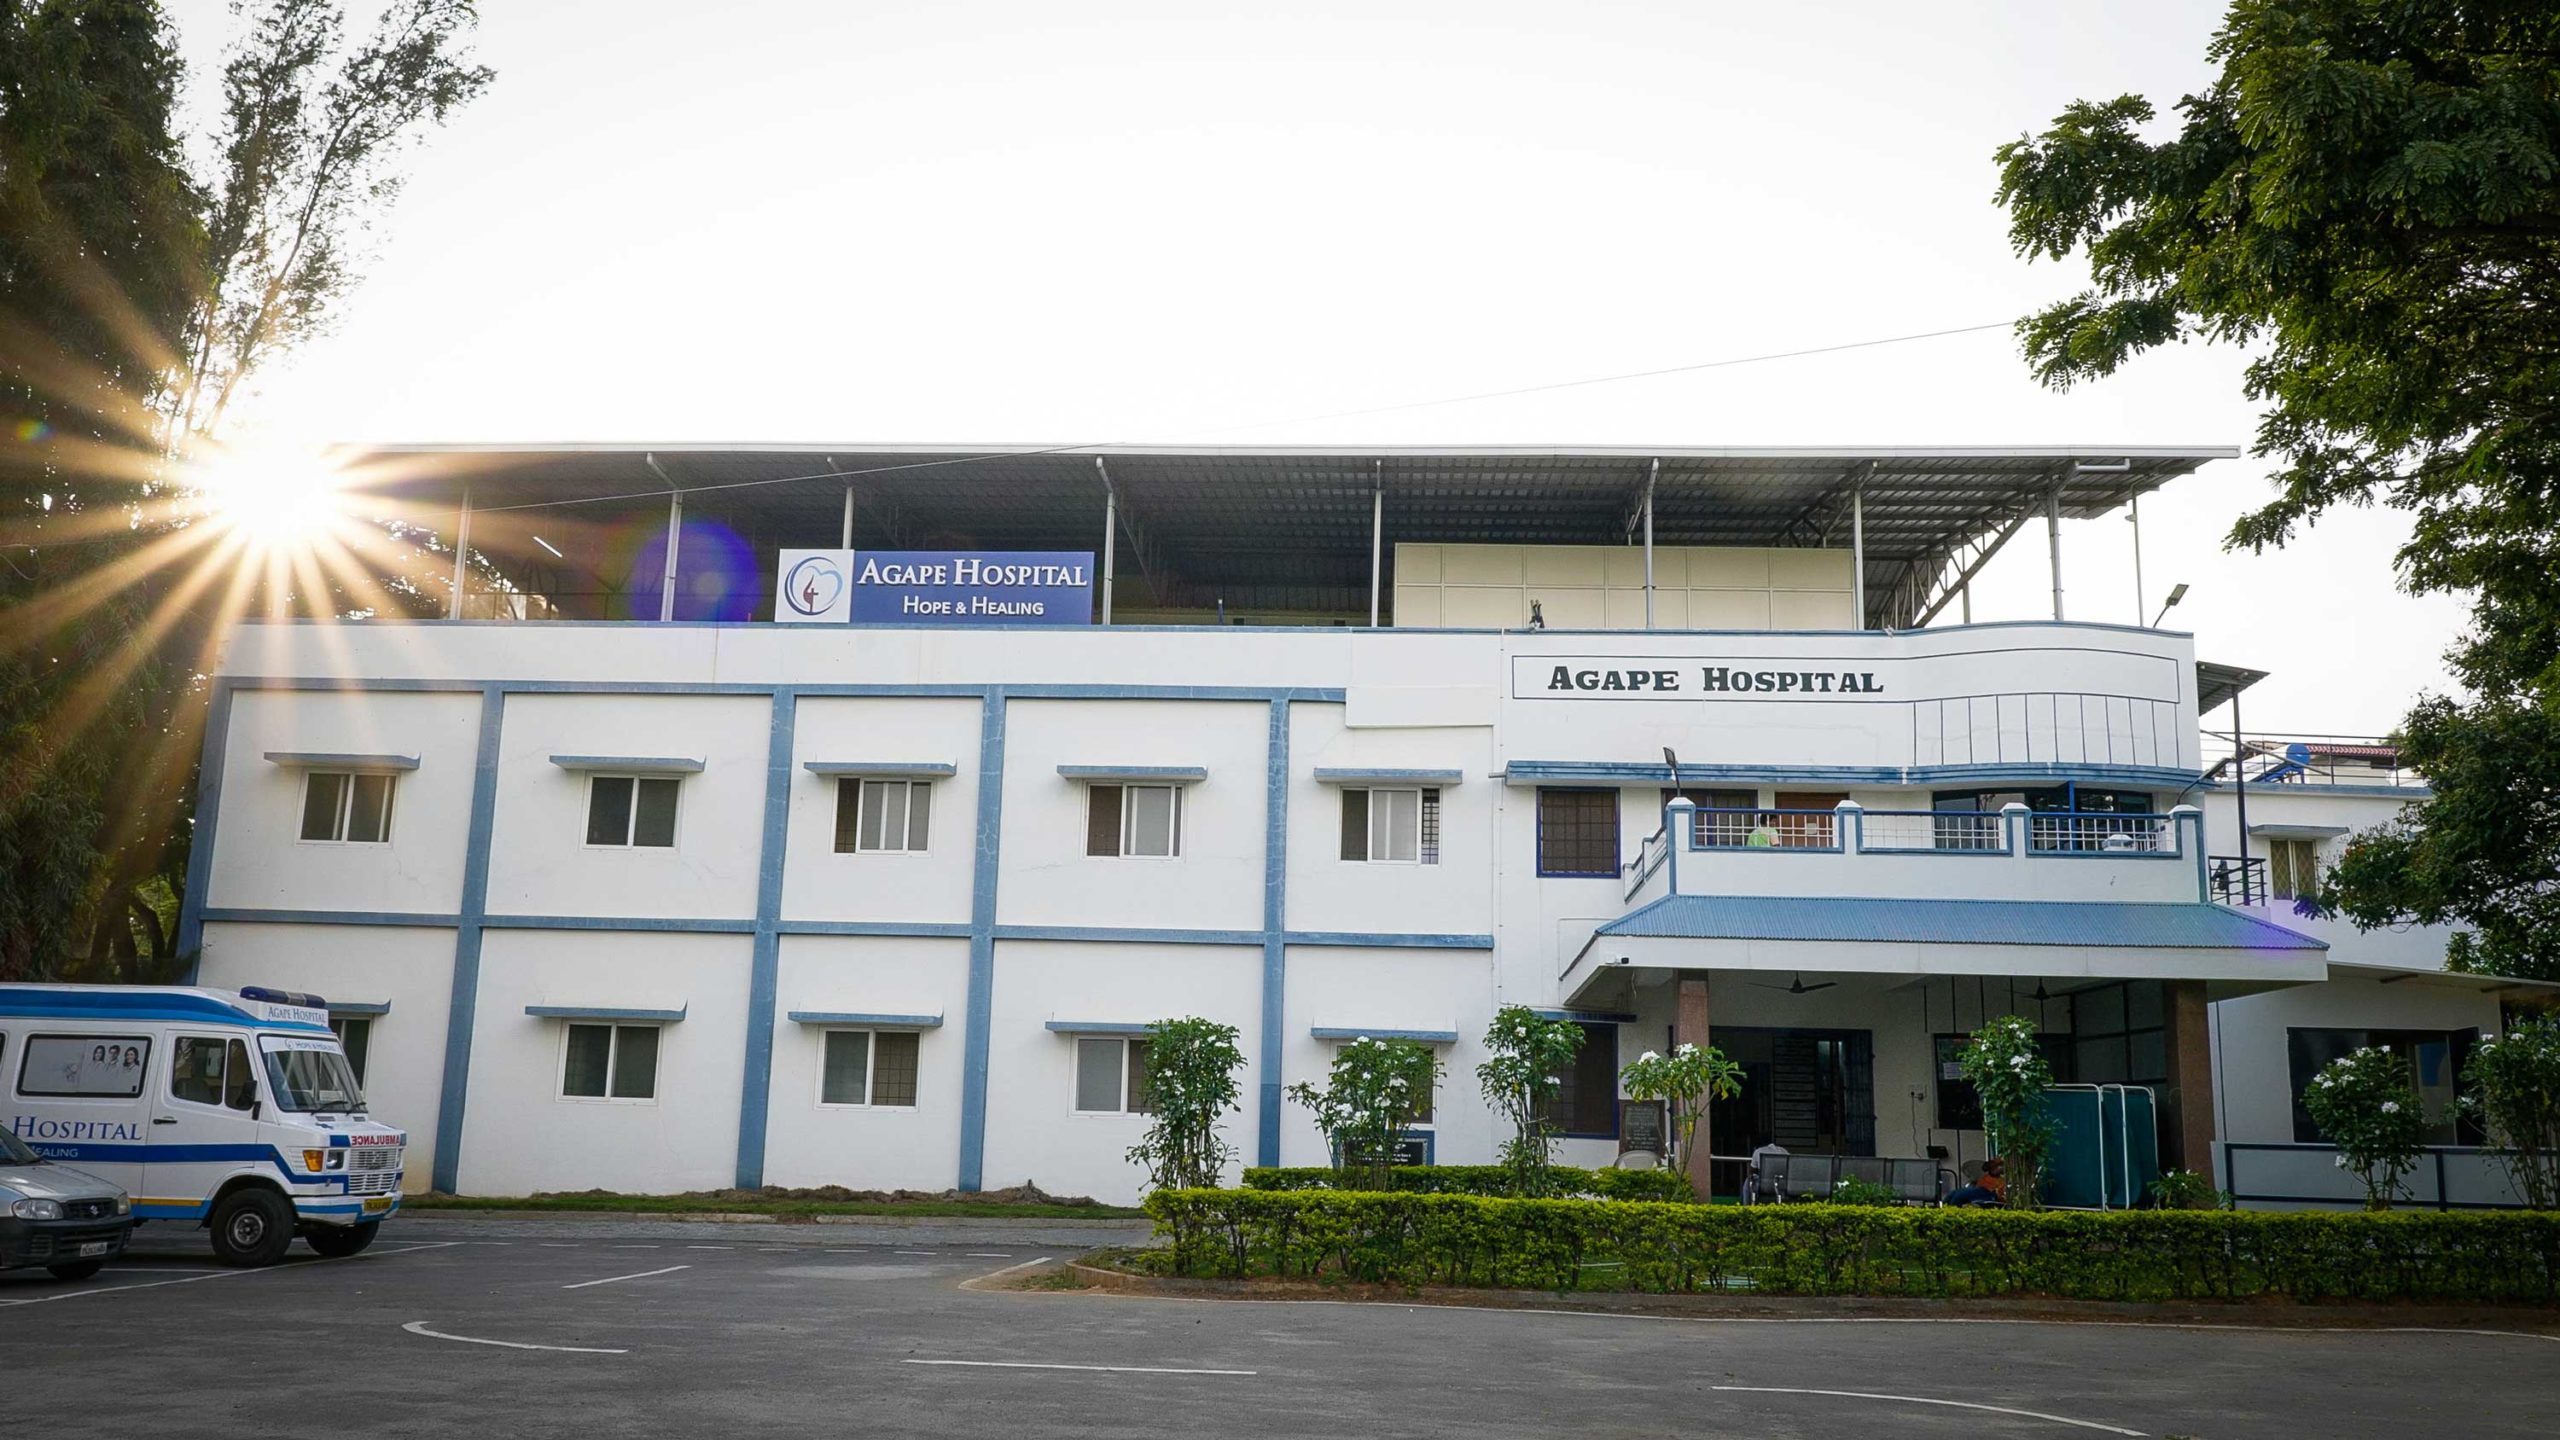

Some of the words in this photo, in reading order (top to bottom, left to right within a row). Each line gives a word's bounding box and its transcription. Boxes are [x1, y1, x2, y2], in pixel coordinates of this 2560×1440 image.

[857, 558, 947, 586] AGAPE
[953, 559, 1088, 588] HOSPITAL
[903, 595, 951, 615] HOPE
[955, 601, 967, 614] &
[972, 596, 1044, 616] HEALING
[1547, 666, 1680, 691] AGAPE
[1702, 667, 1885, 693] HOSPITAL
[268, 1007, 291, 1019] AGAPE
[293, 1008, 327, 1023] HOSPITAL
[13, 1115, 143, 1140] HOSPITAL
[32, 1145, 80, 1158] EALING
